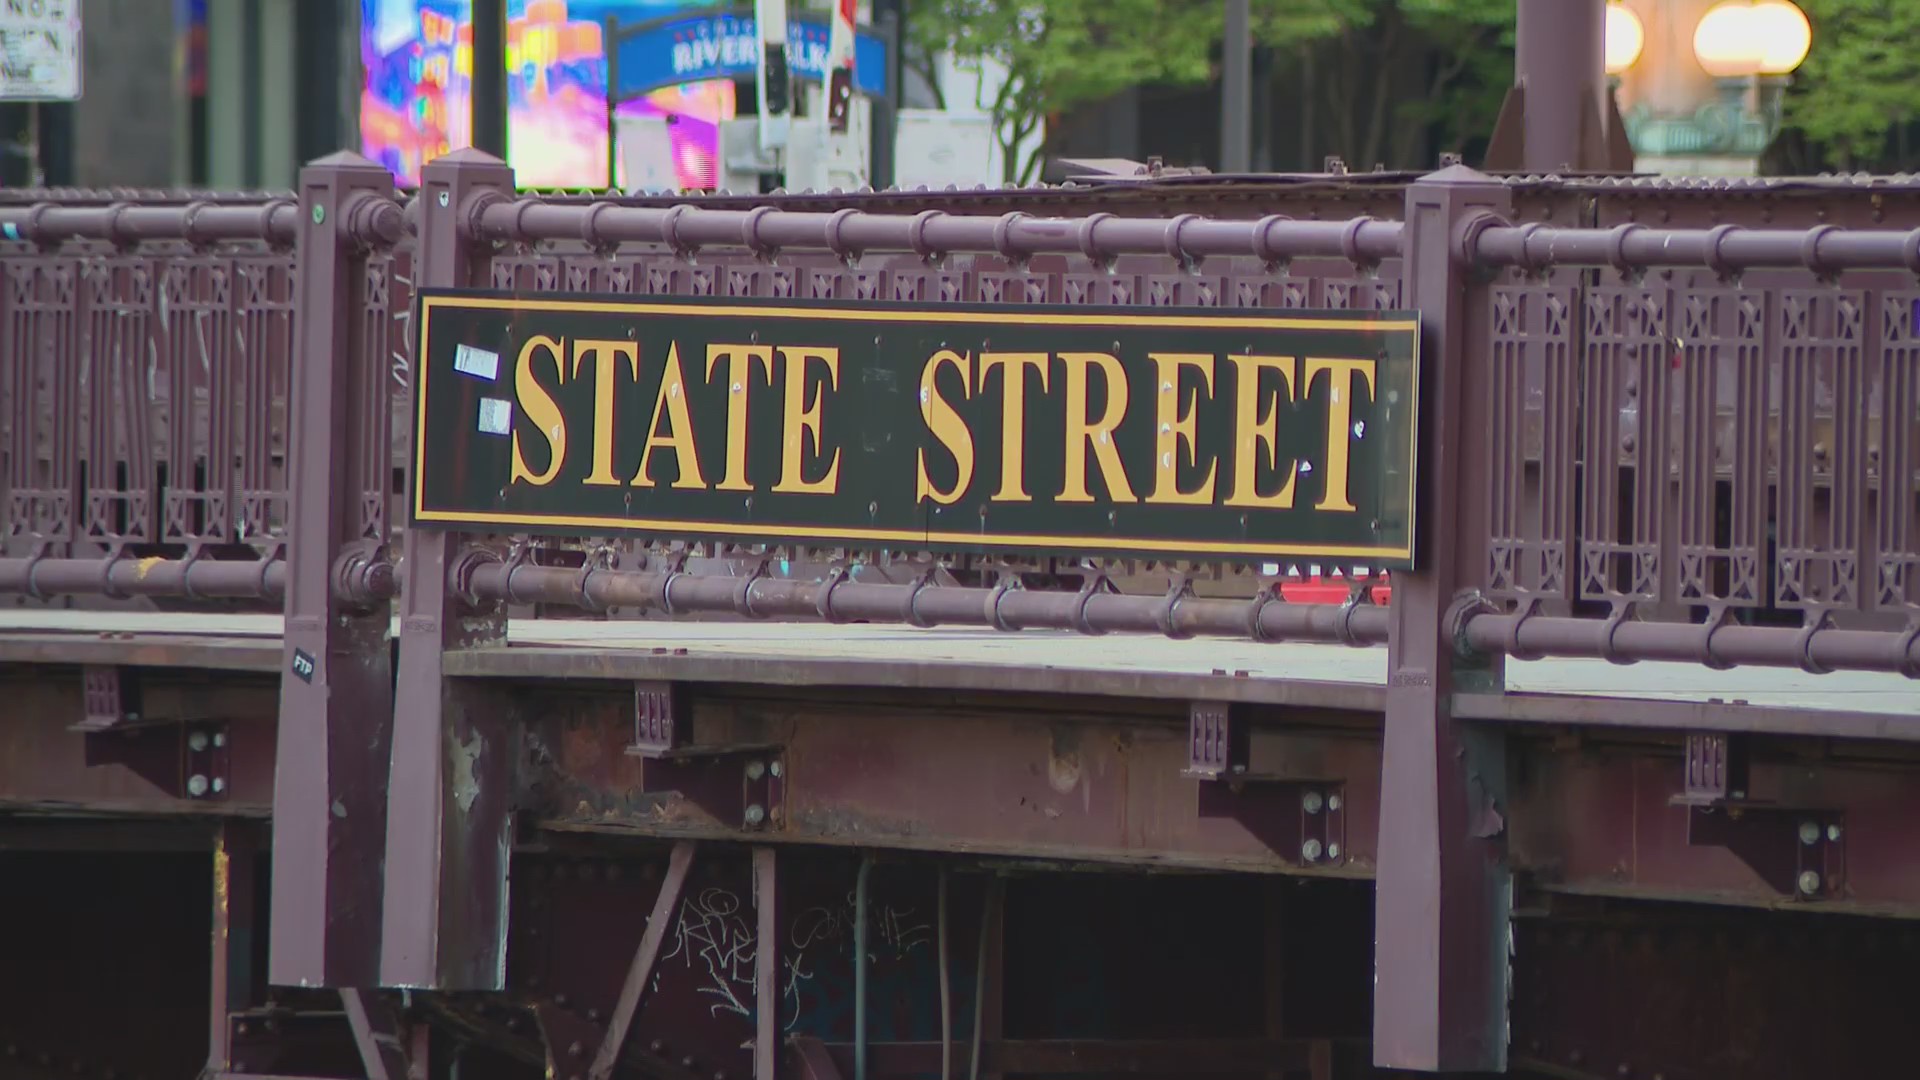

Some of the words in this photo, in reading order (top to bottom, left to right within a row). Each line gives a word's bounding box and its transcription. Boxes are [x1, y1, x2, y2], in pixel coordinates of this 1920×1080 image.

[673, 34, 831, 74] RIVERLK
[510, 334, 842, 495] STATE
[916, 349, 1377, 512] STREET
[294, 654, 313, 675] FTP
